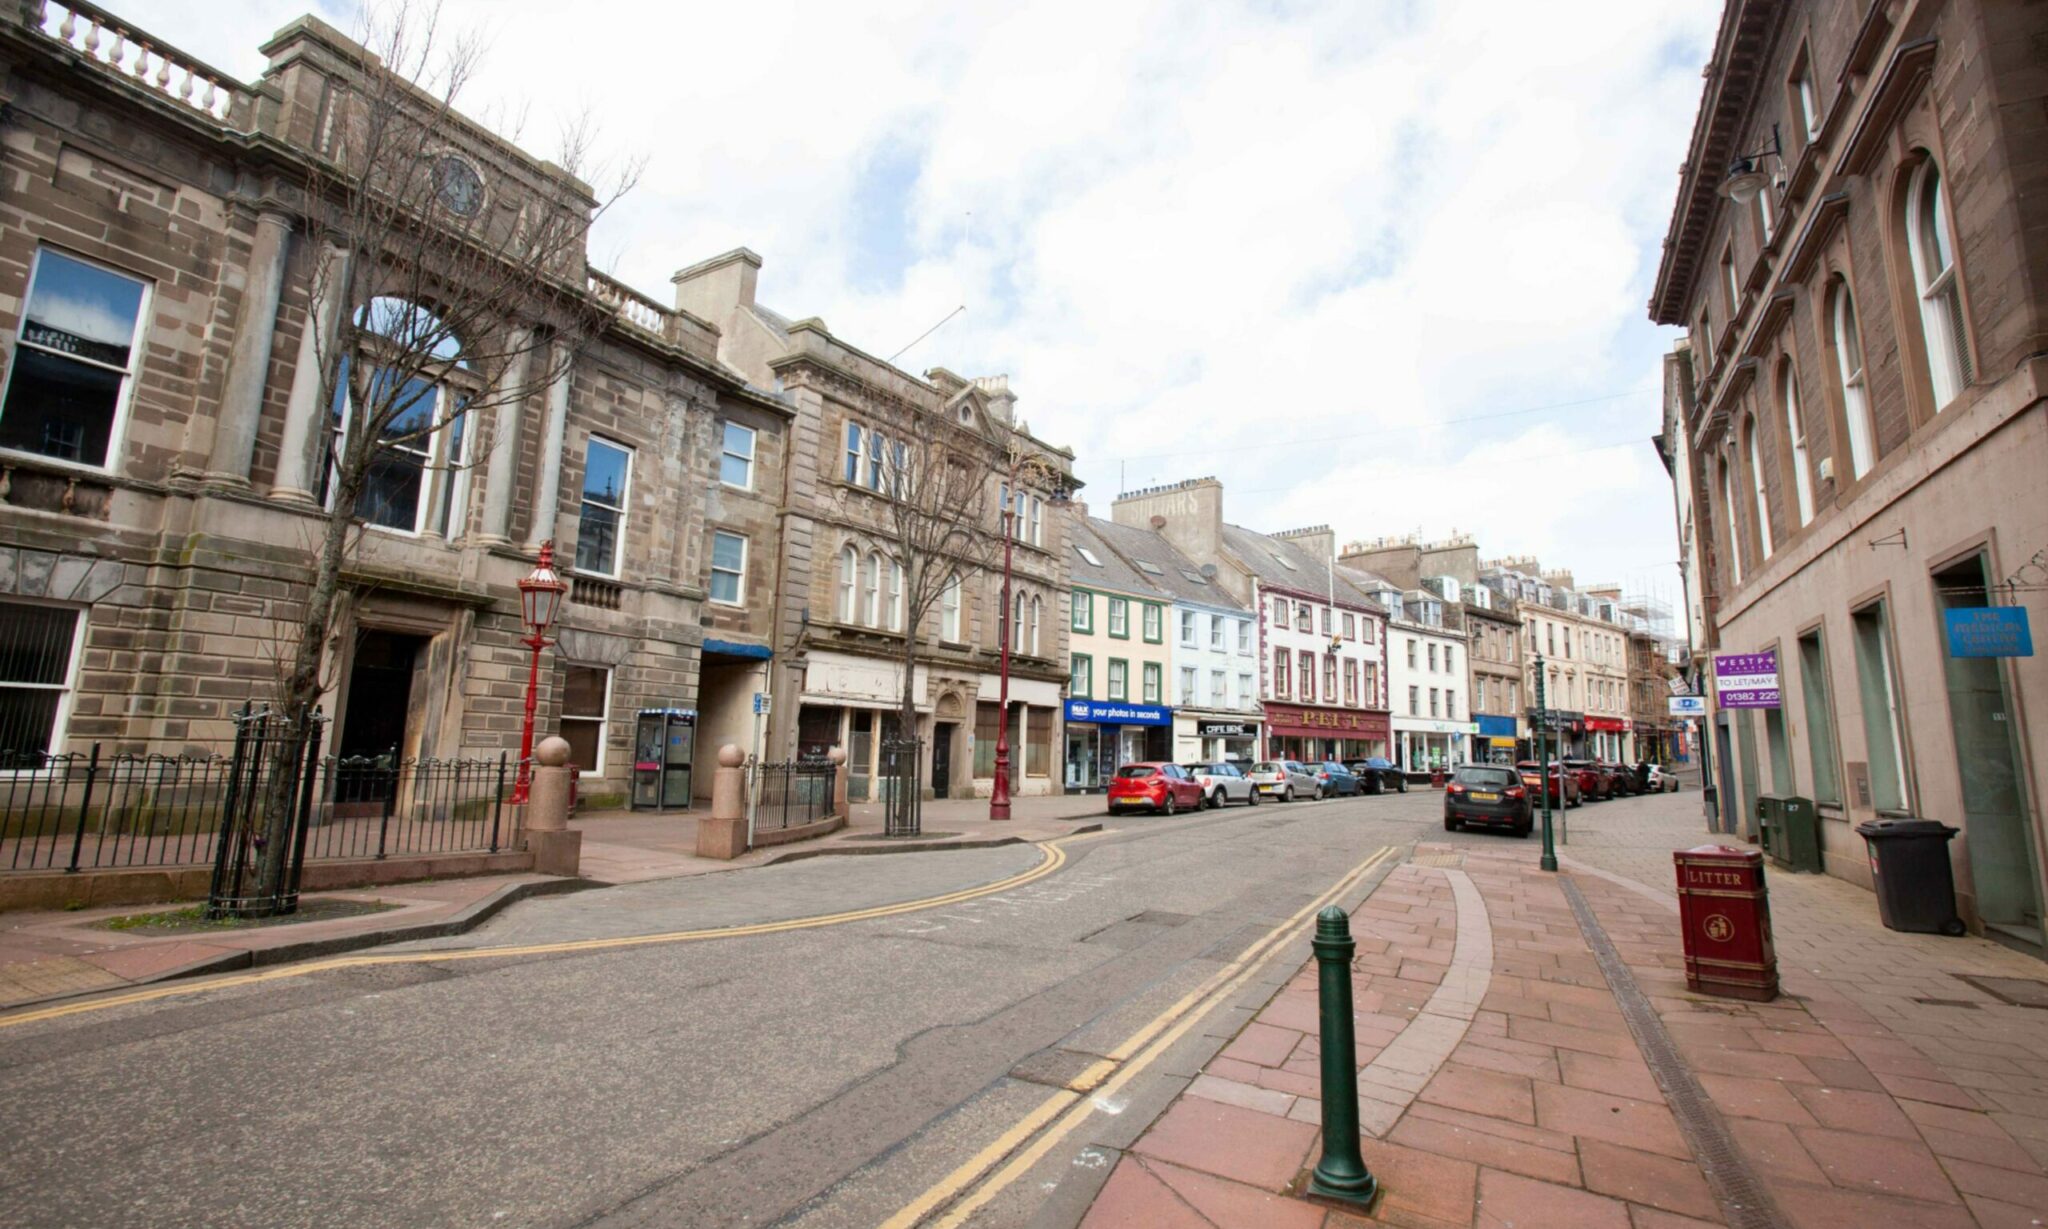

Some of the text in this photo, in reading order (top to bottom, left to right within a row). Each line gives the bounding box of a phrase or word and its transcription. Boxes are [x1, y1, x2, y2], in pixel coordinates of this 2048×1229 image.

[1719, 679, 1731, 687] TO
[1726, 692, 1755, 701] 01382
[1071, 705, 1089, 713] MAX
[1093, 708, 1107, 718] your
[1108, 707, 1129, 719] photos
[1130, 708, 1136, 718] in
[1136, 710, 1160, 720] seconds
[1689, 870, 1742, 886] LITTER
